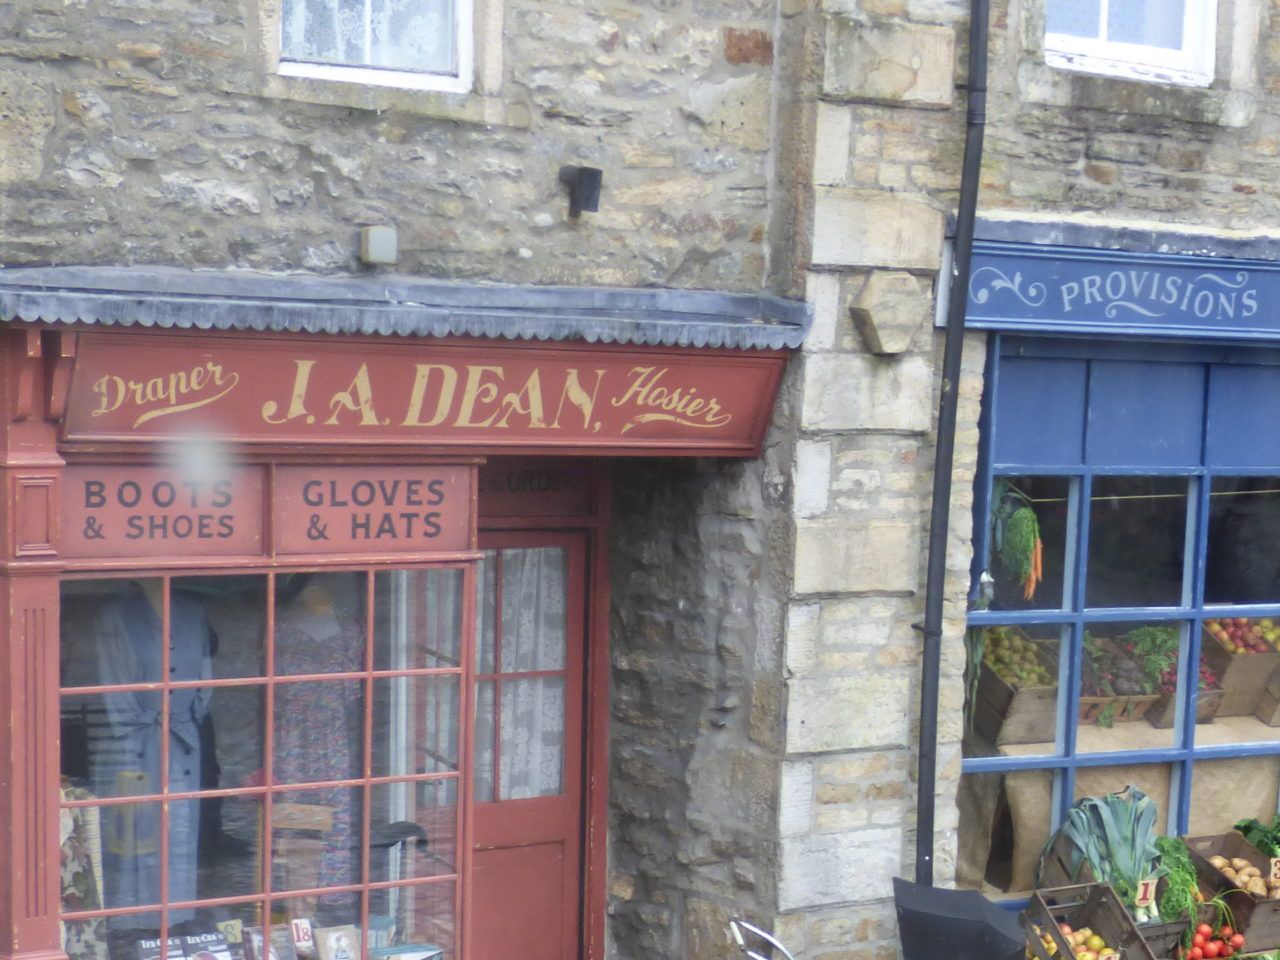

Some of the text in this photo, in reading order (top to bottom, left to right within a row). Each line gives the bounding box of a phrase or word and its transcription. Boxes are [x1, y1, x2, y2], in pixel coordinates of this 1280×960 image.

[1060, 271, 1258, 319] PROVISIONS
[91, 361, 239, 420] Draper
[611, 366, 733, 426] Hosier
[83, 480, 233, 508] BOOTS
[302, 479, 445, 507] GLOVES
[82, 514, 235, 540] & SHOES
[306, 511, 442, 541] & HATS
